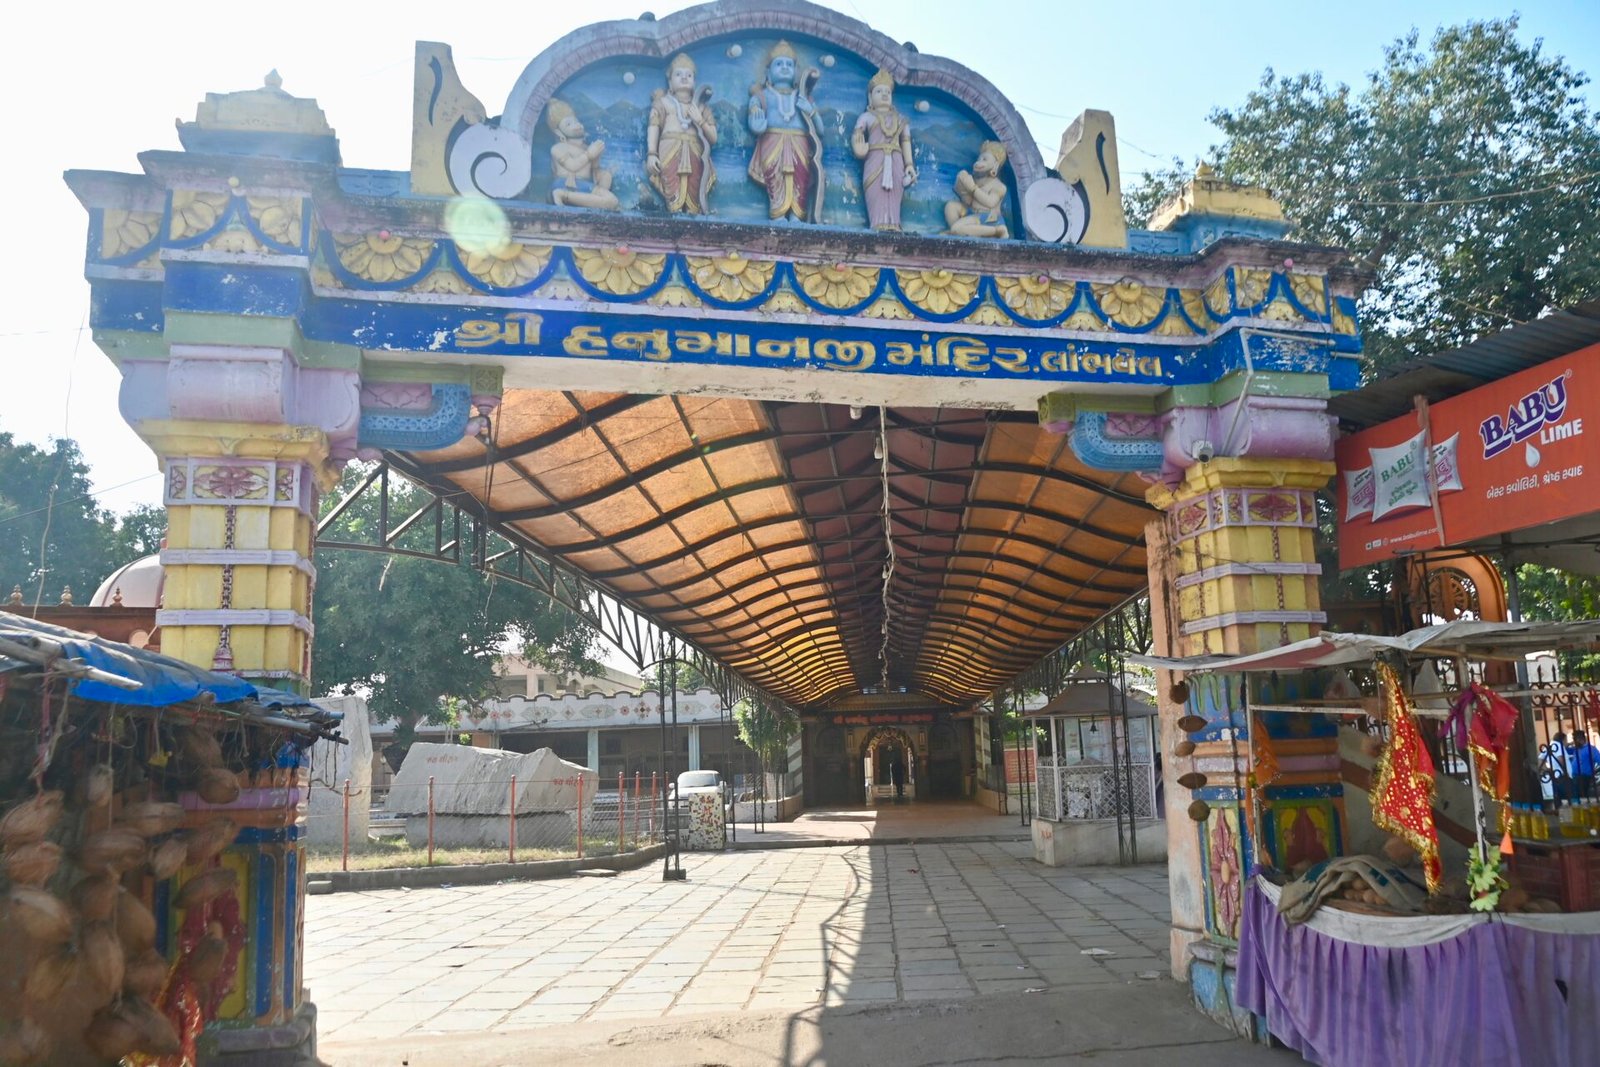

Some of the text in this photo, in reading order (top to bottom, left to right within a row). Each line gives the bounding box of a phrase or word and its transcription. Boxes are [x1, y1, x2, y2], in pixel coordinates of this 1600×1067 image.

[455, 312, 544, 347] શ્રી
[562, 325, 876, 372] હનુમાનજી
[1479, 375, 1567, 459] BABU
[1540, 418, 1583, 446] LIME
[1381, 452, 1415, 482] BABU
